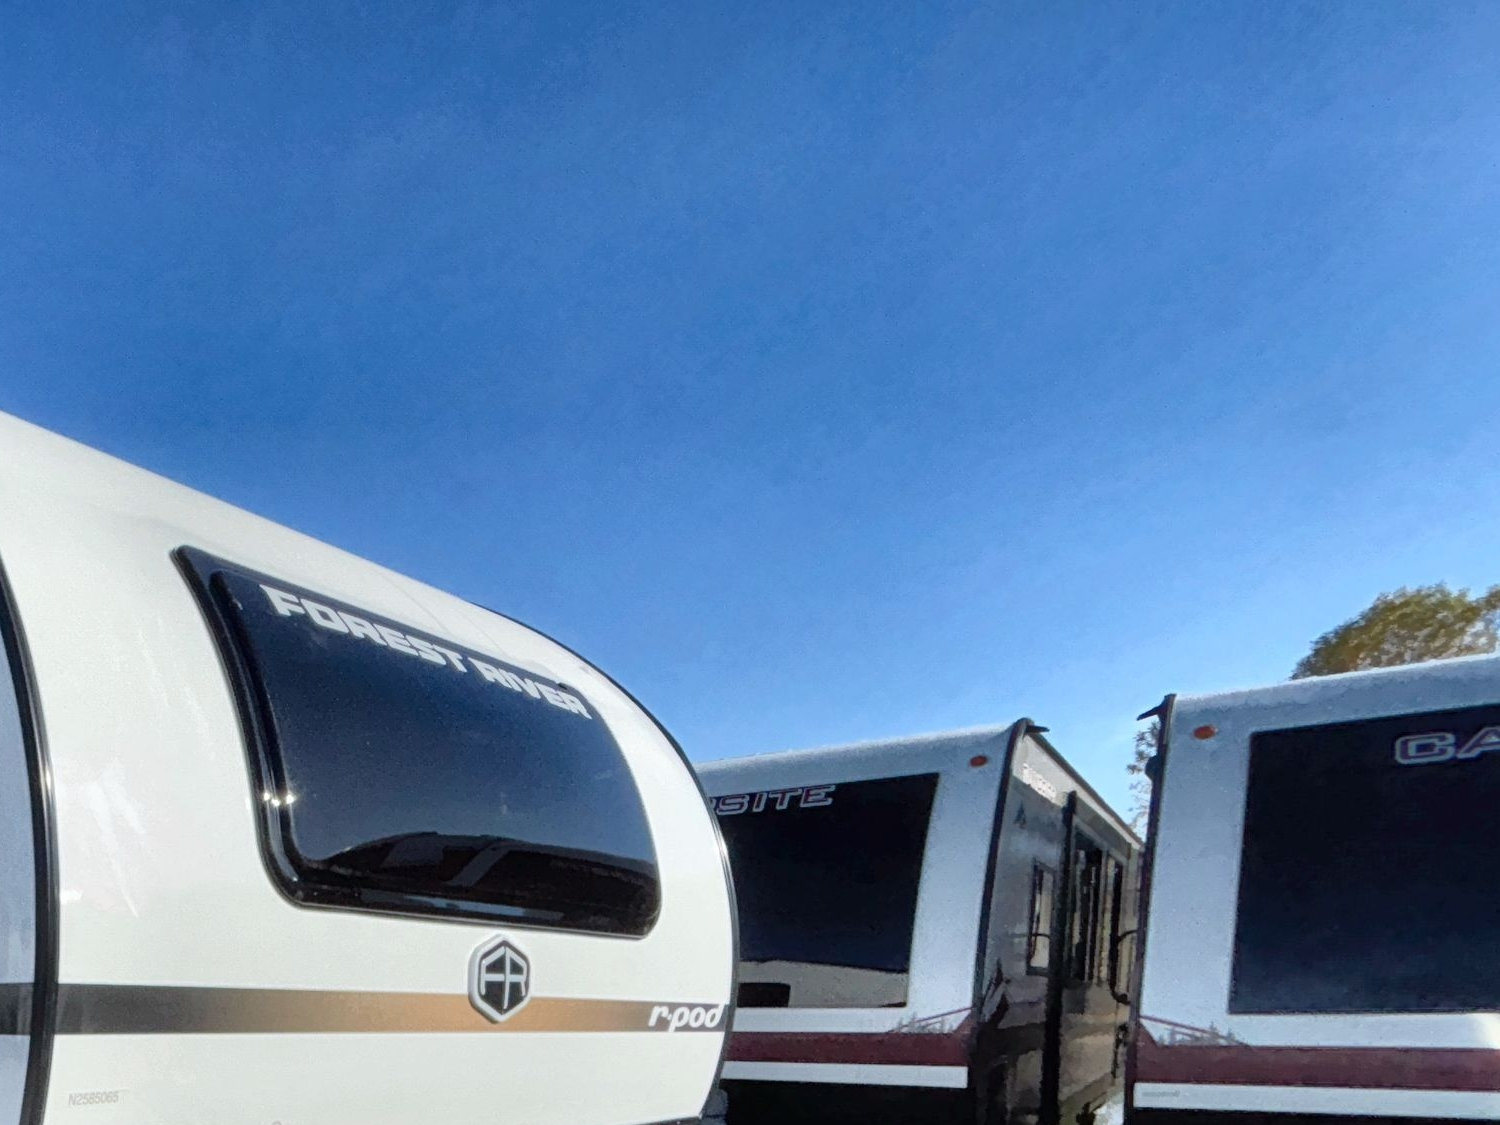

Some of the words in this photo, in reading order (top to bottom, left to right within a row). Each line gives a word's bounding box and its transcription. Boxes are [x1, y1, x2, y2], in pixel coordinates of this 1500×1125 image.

[259, 584, 468, 673] FOREST
[468, 657, 593, 720] RIVER
[708, 784, 837, 816] SITE
